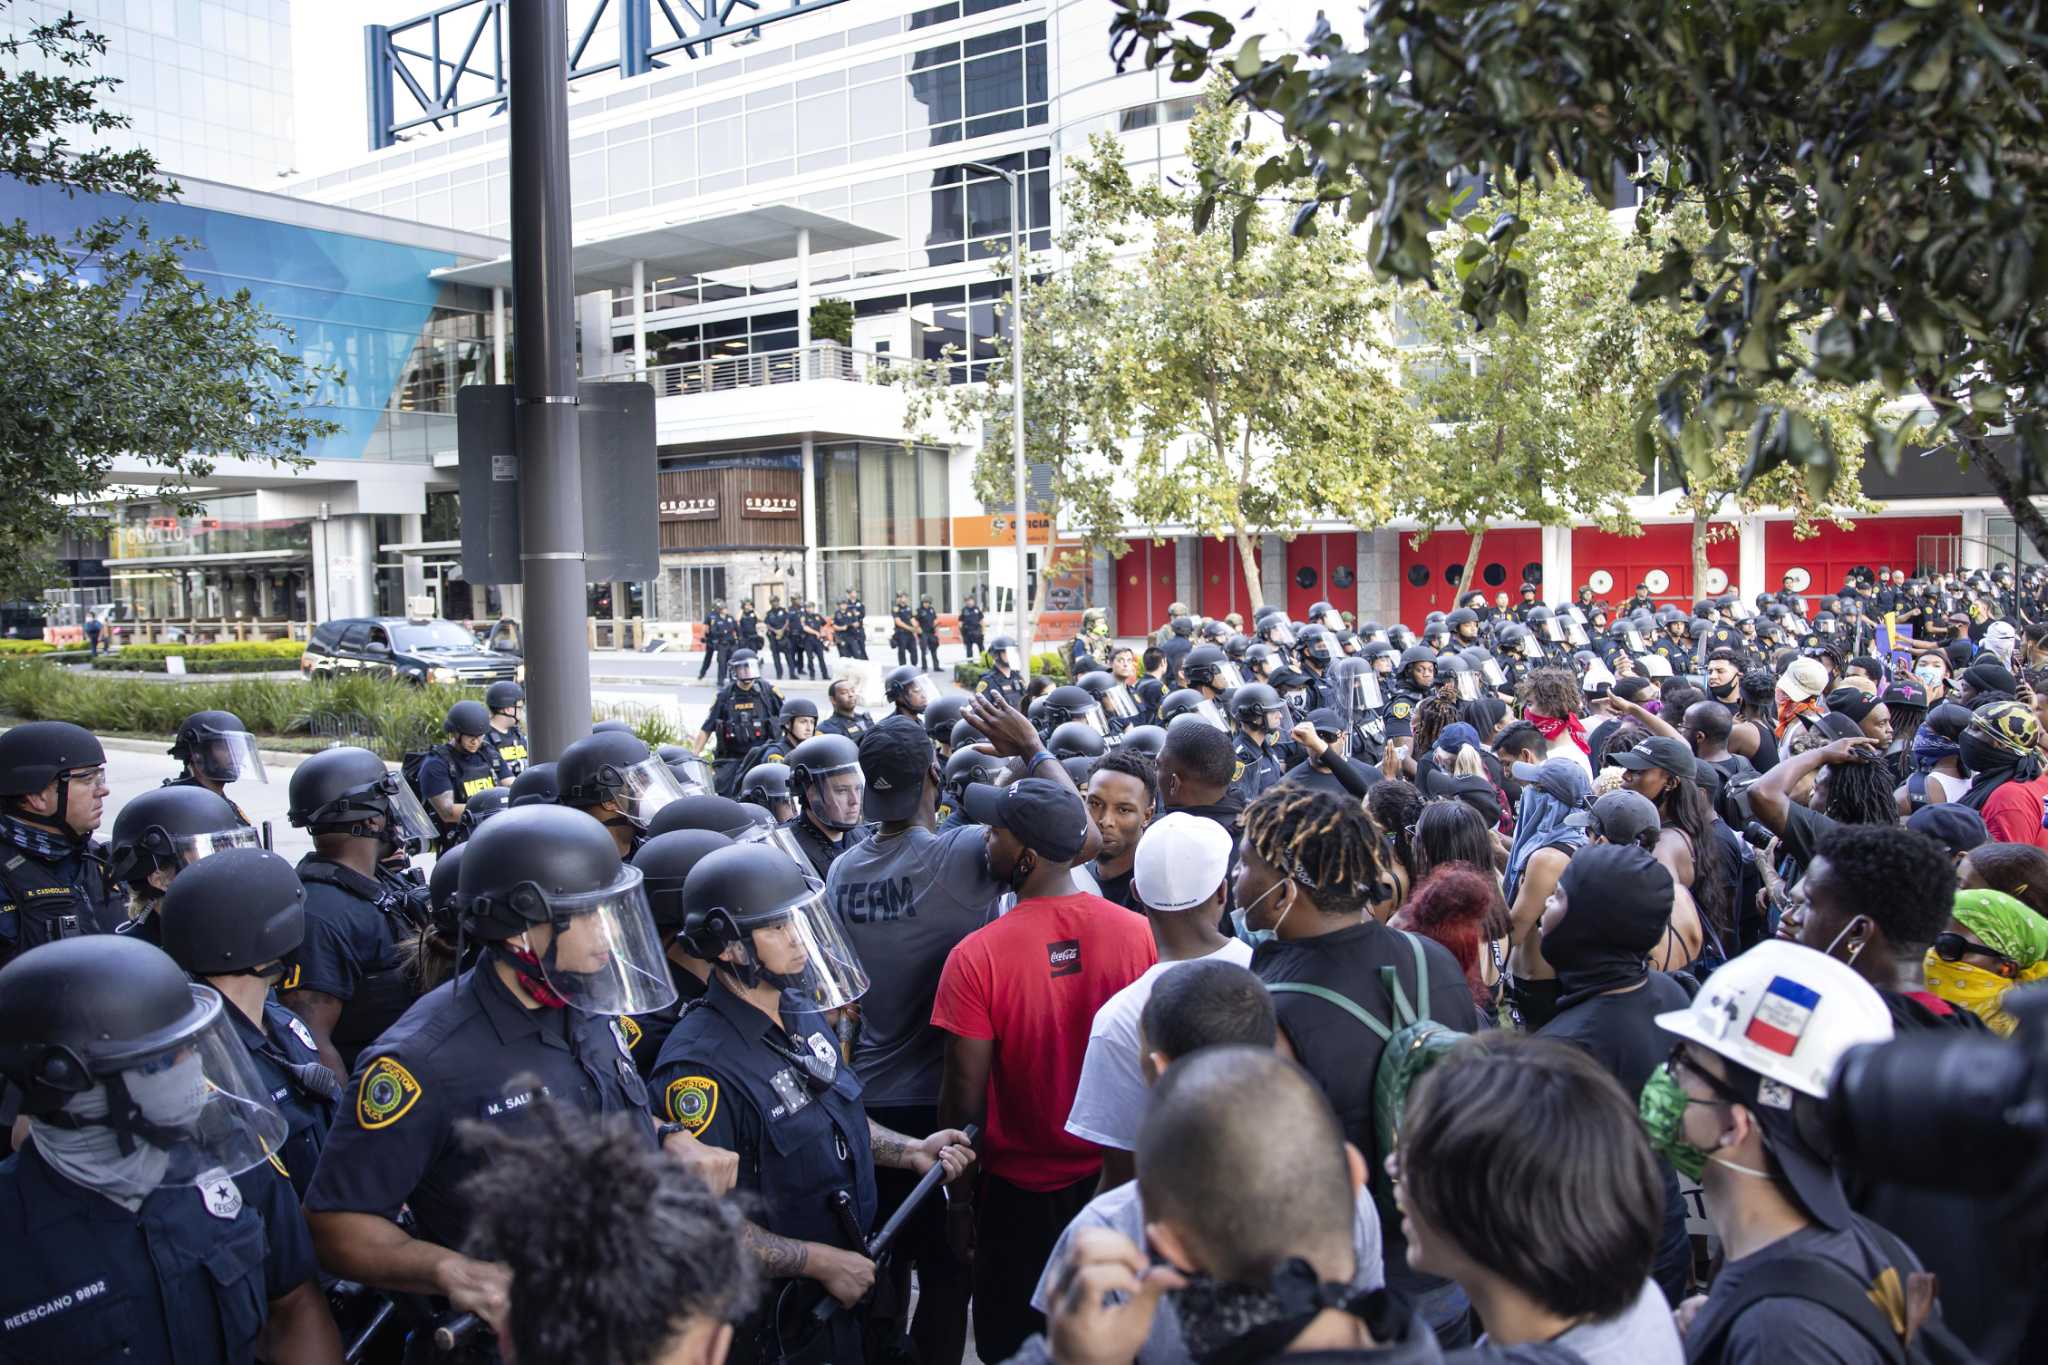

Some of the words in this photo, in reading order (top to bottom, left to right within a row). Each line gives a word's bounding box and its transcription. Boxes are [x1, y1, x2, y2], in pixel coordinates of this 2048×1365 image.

[659, 498, 716, 510] GROTTO
[745, 497, 797, 508] GROTTO
[835, 876, 917, 924] TEAM
[380, 1062, 416, 1093] HOUSTON
[671, 1080, 711, 1092] HOUSTON
[487, 1103, 504, 1116] M.
[75, 1280, 106, 1302] 9892
